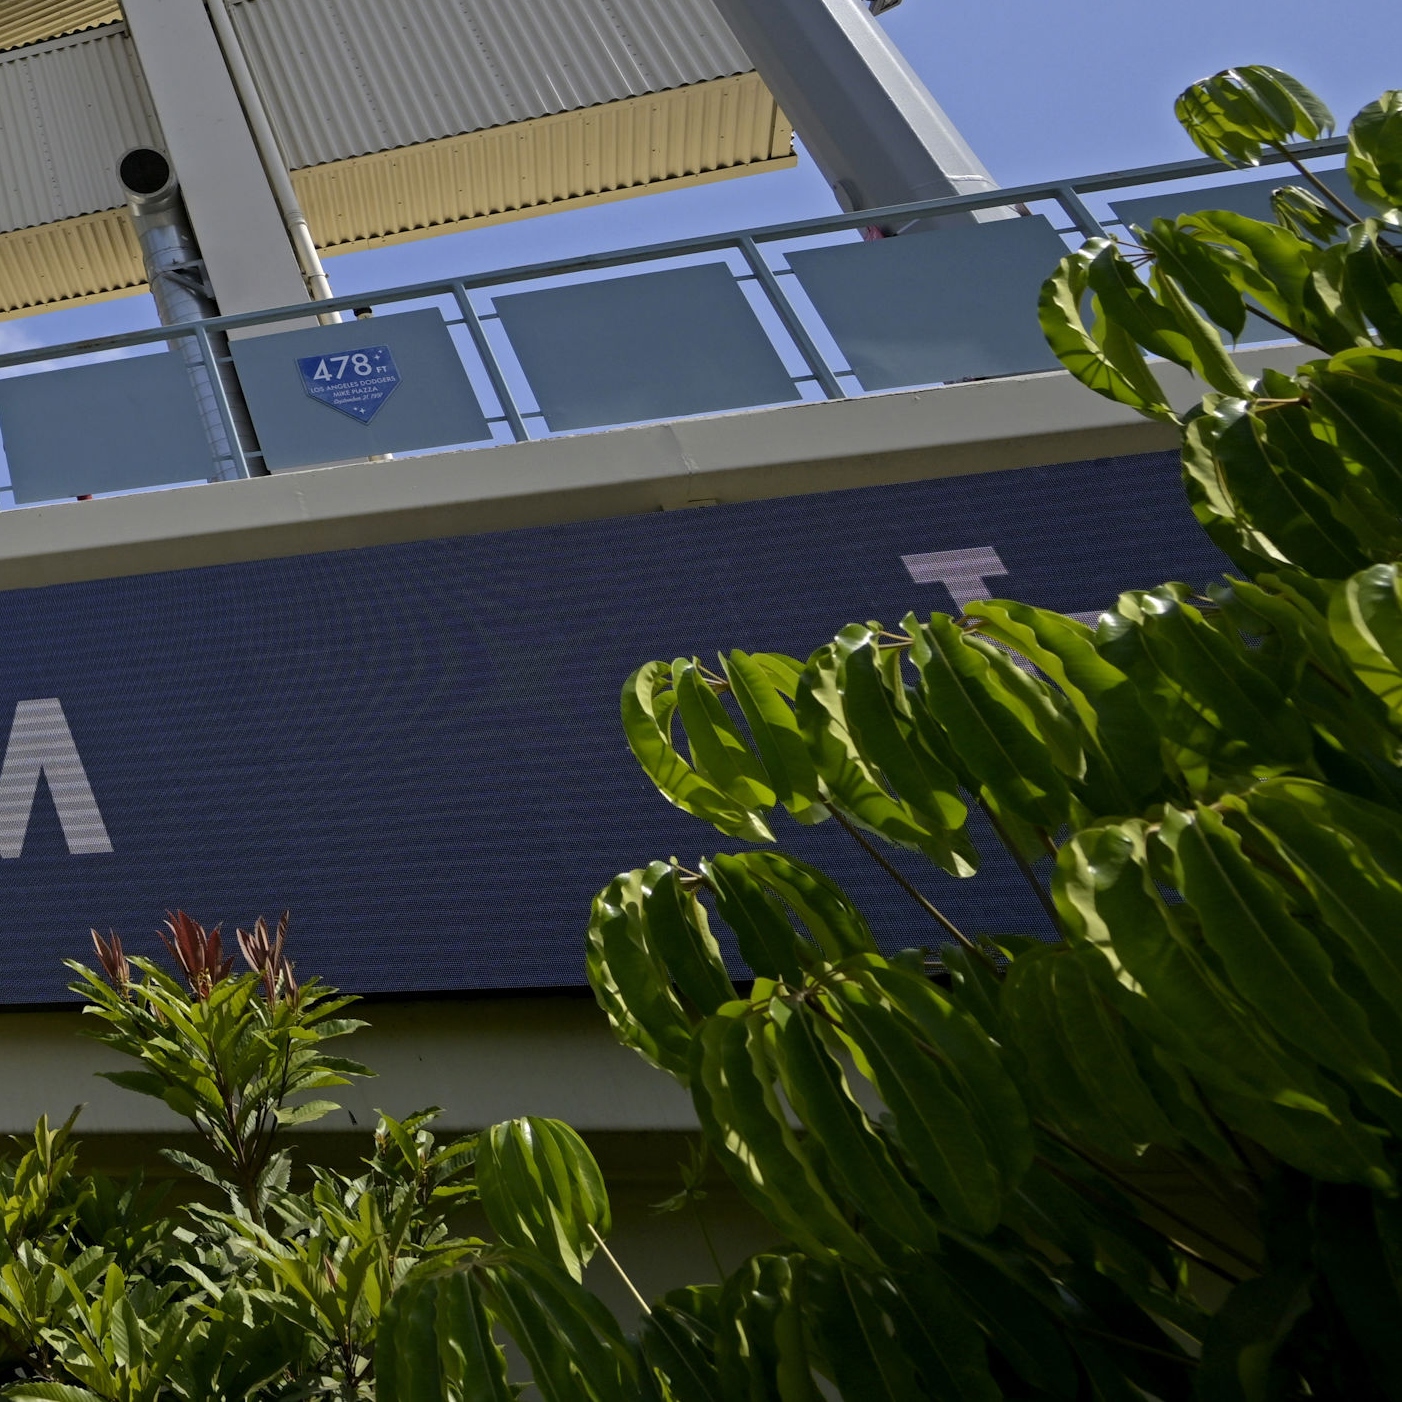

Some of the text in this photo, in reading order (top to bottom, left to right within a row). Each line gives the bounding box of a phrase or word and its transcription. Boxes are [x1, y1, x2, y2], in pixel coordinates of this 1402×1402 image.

[313, 353, 372, 381] 478
[310, 375, 396, 394] LOS ANGELES DODGERS
[333, 385, 378, 398] MIKE PIAZZA
